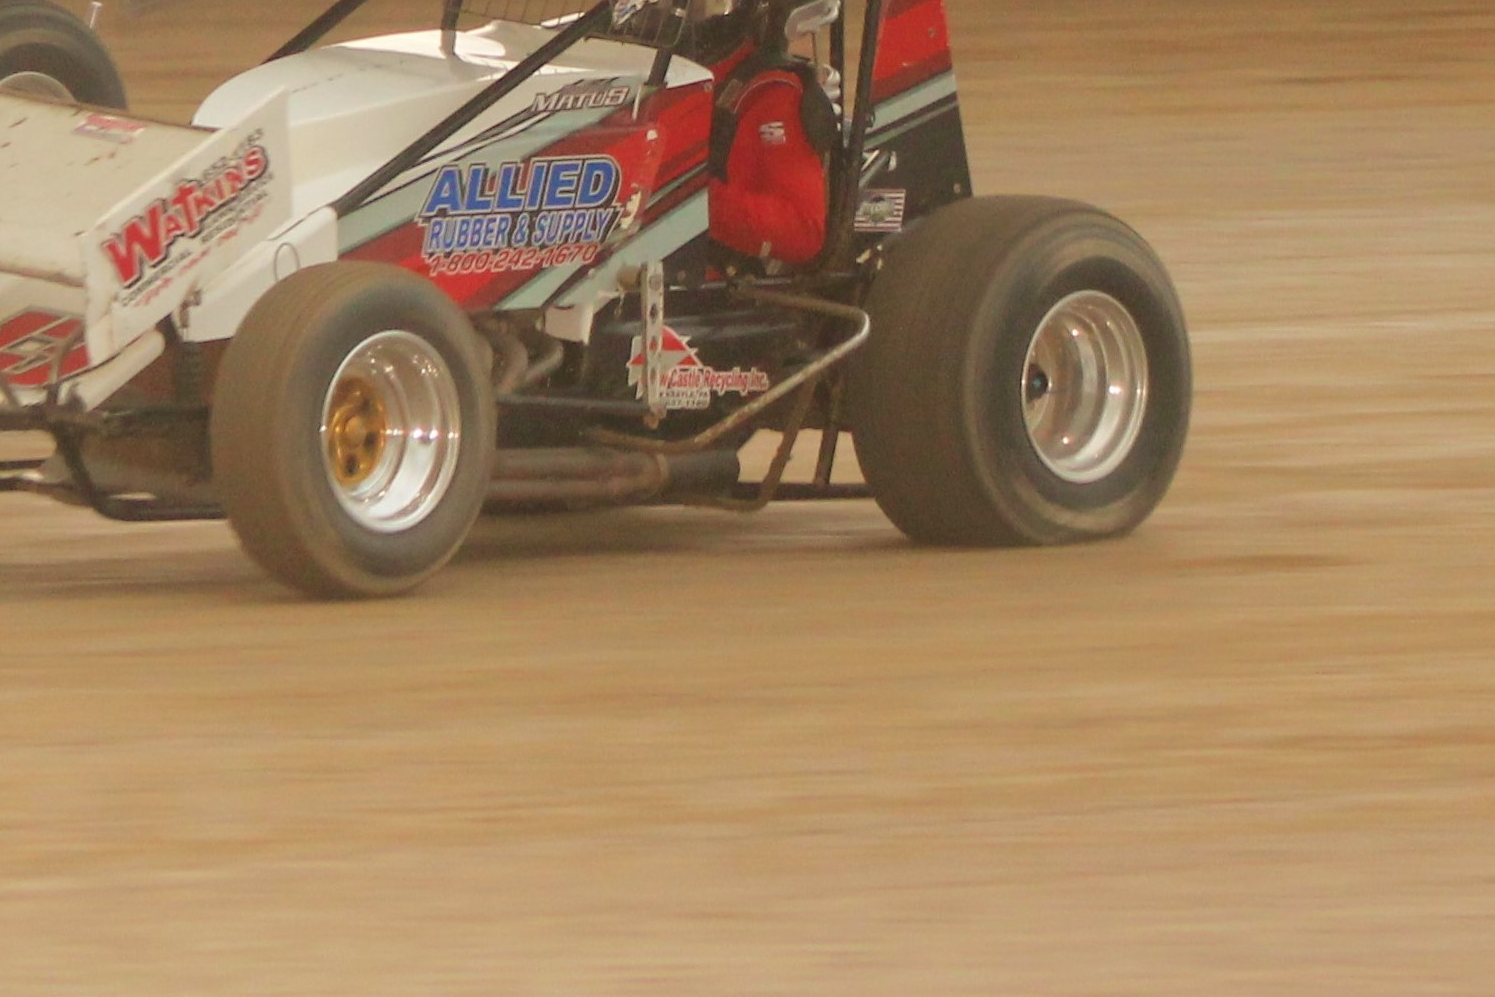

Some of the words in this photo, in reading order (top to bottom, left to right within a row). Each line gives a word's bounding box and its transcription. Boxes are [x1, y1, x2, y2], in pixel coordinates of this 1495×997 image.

[422, 159, 617, 216] ALLIED
[427, 215, 510, 253] RUBBER
[512, 216, 531, 247] &
[533, 208, 614, 246] SUPPLY
